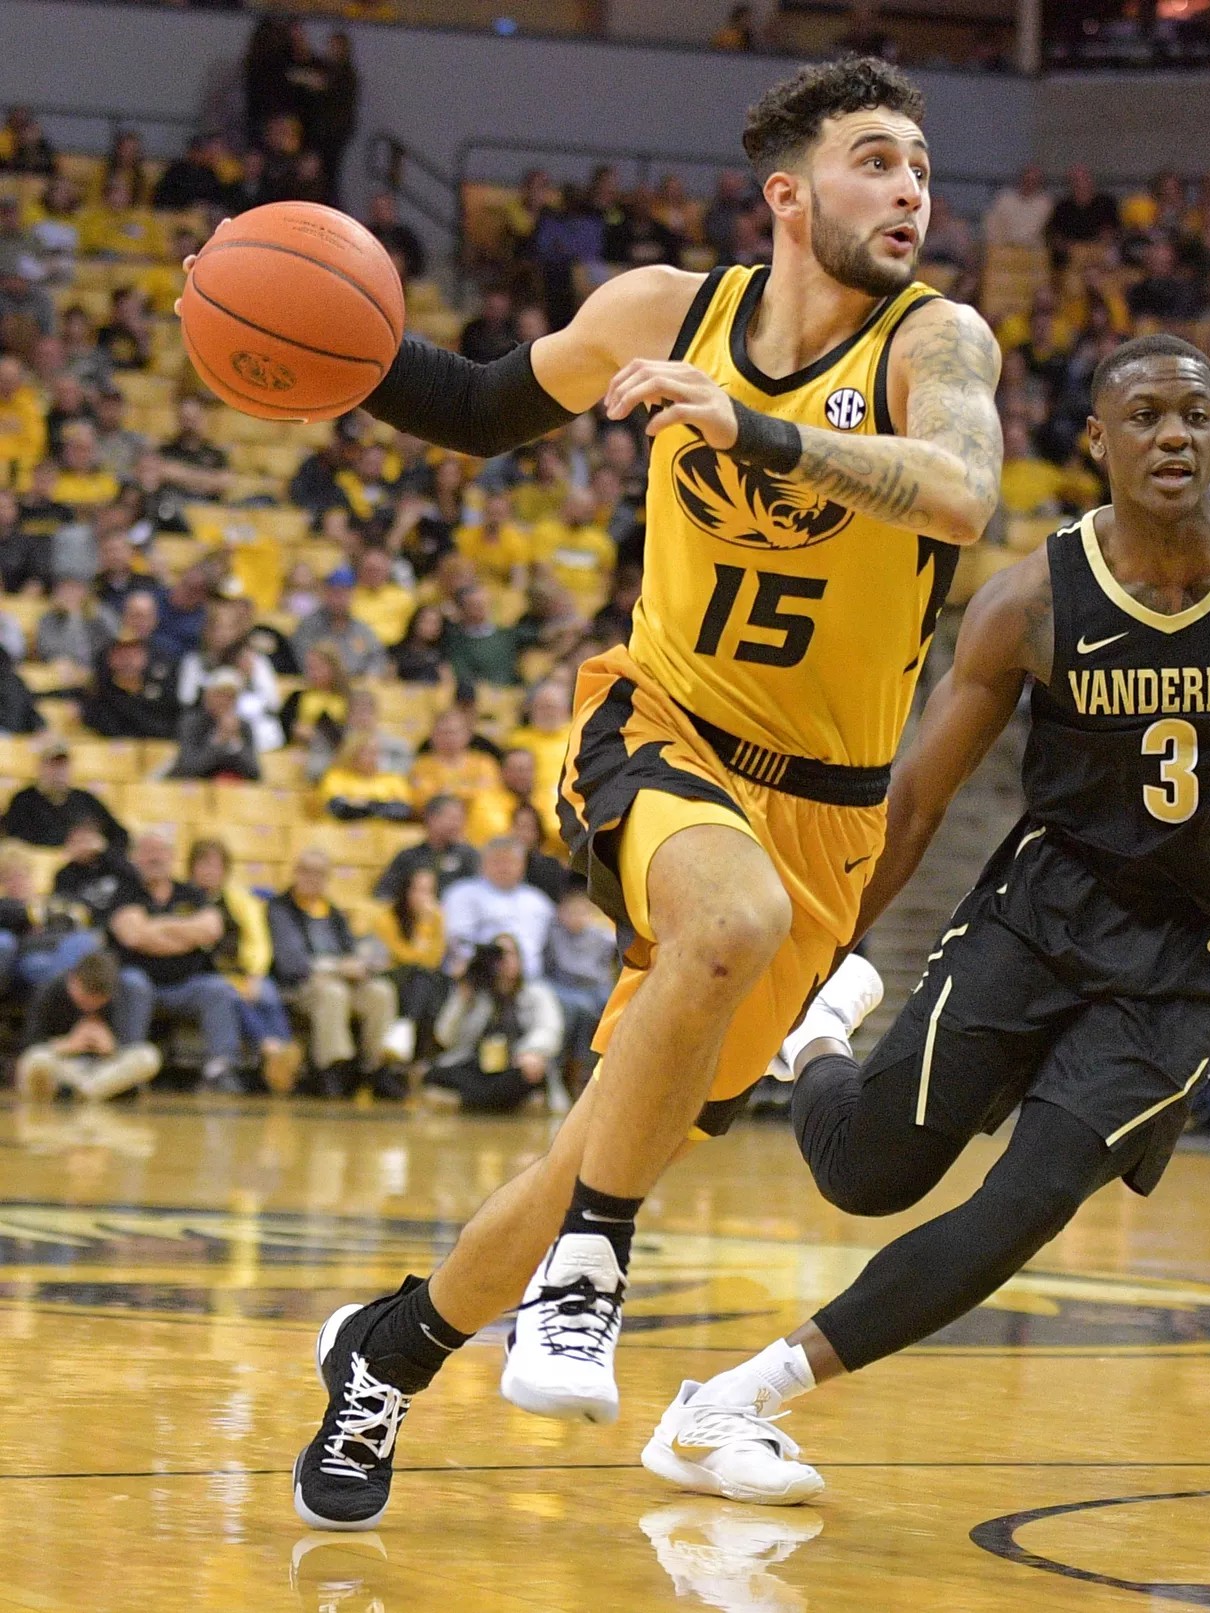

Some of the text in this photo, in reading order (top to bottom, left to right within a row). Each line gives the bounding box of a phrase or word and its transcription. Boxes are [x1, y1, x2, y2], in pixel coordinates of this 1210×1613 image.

[826, 388, 867, 430] SEC
[694, 562, 828, 668] 15
[1141, 718, 1199, 824] 3
